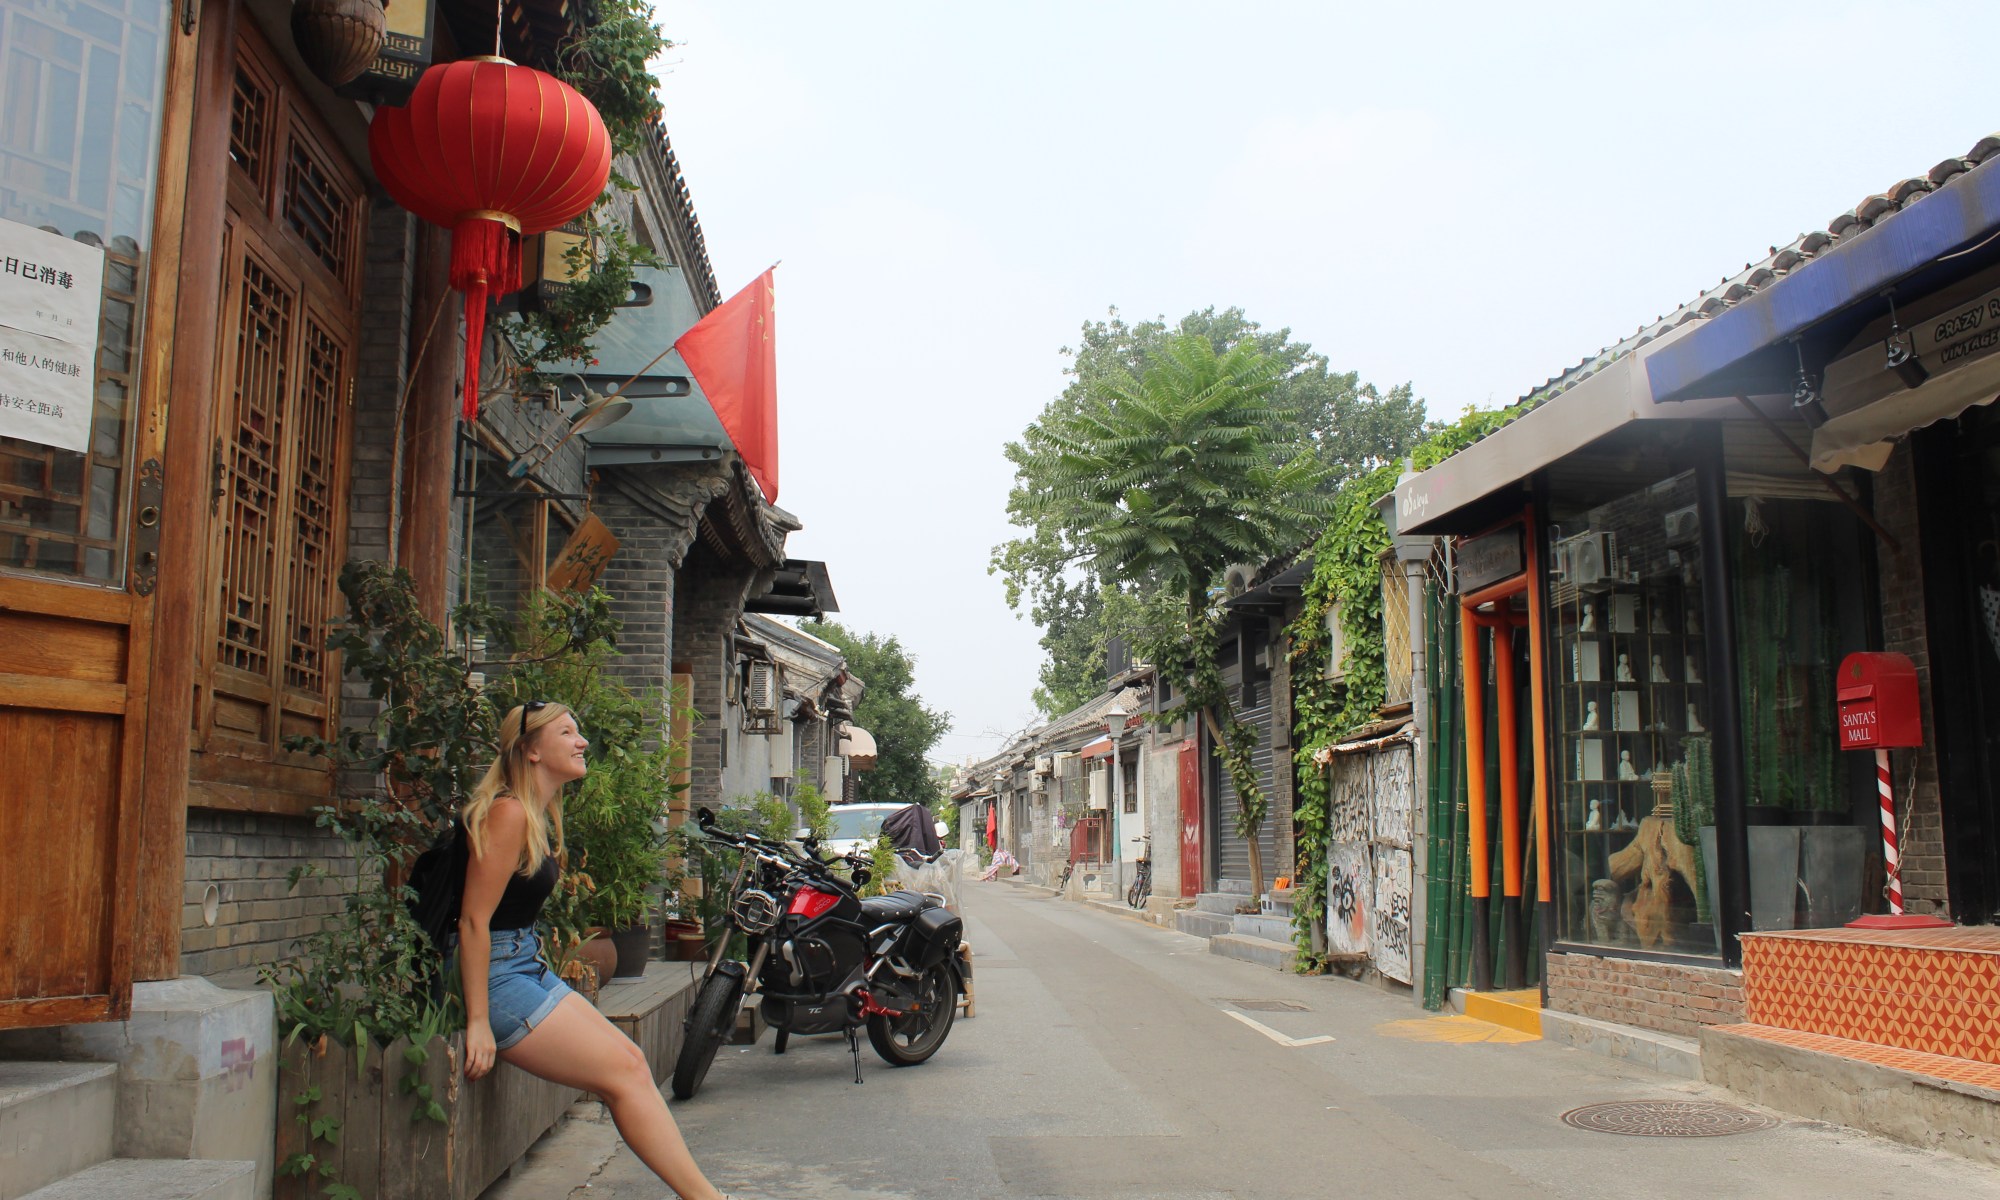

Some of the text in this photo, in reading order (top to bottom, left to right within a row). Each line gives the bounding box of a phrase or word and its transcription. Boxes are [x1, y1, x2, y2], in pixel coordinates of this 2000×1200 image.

[0, 256, 73, 289] 日已消毒
[1935, 305, 1984, 342] CRAZY
[2, 348, 80, 377] 和他人的健康
[1941, 330, 1998, 364] VINTAGE
[1843, 711, 1876, 727] SANTA'S
[1848, 728, 1871, 742] MALL
